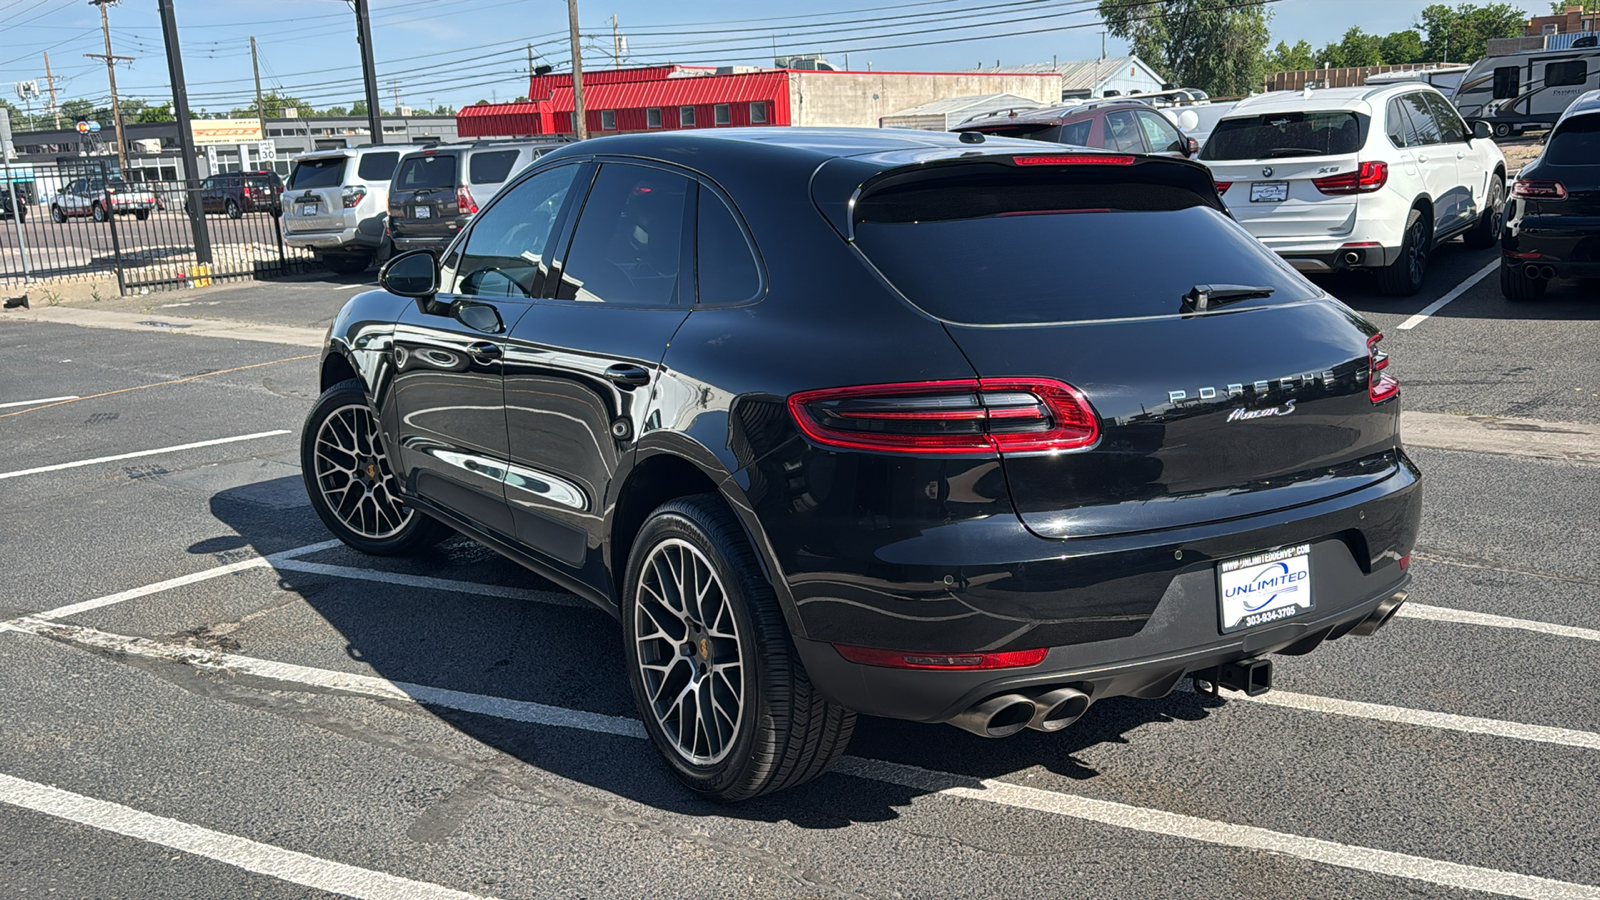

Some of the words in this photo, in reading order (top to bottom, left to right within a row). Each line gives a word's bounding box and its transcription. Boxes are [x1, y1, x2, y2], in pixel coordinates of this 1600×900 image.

[262, 150, 275, 159] 30
[1168, 370, 1335, 403] PORSCHE
[1226, 407, 1279, 423] Macan
[1279, 399, 1297, 416] S
[1225, 570, 1307, 598] UNLIMITED
[1246, 606, 1296, 627] 303-934-3705
